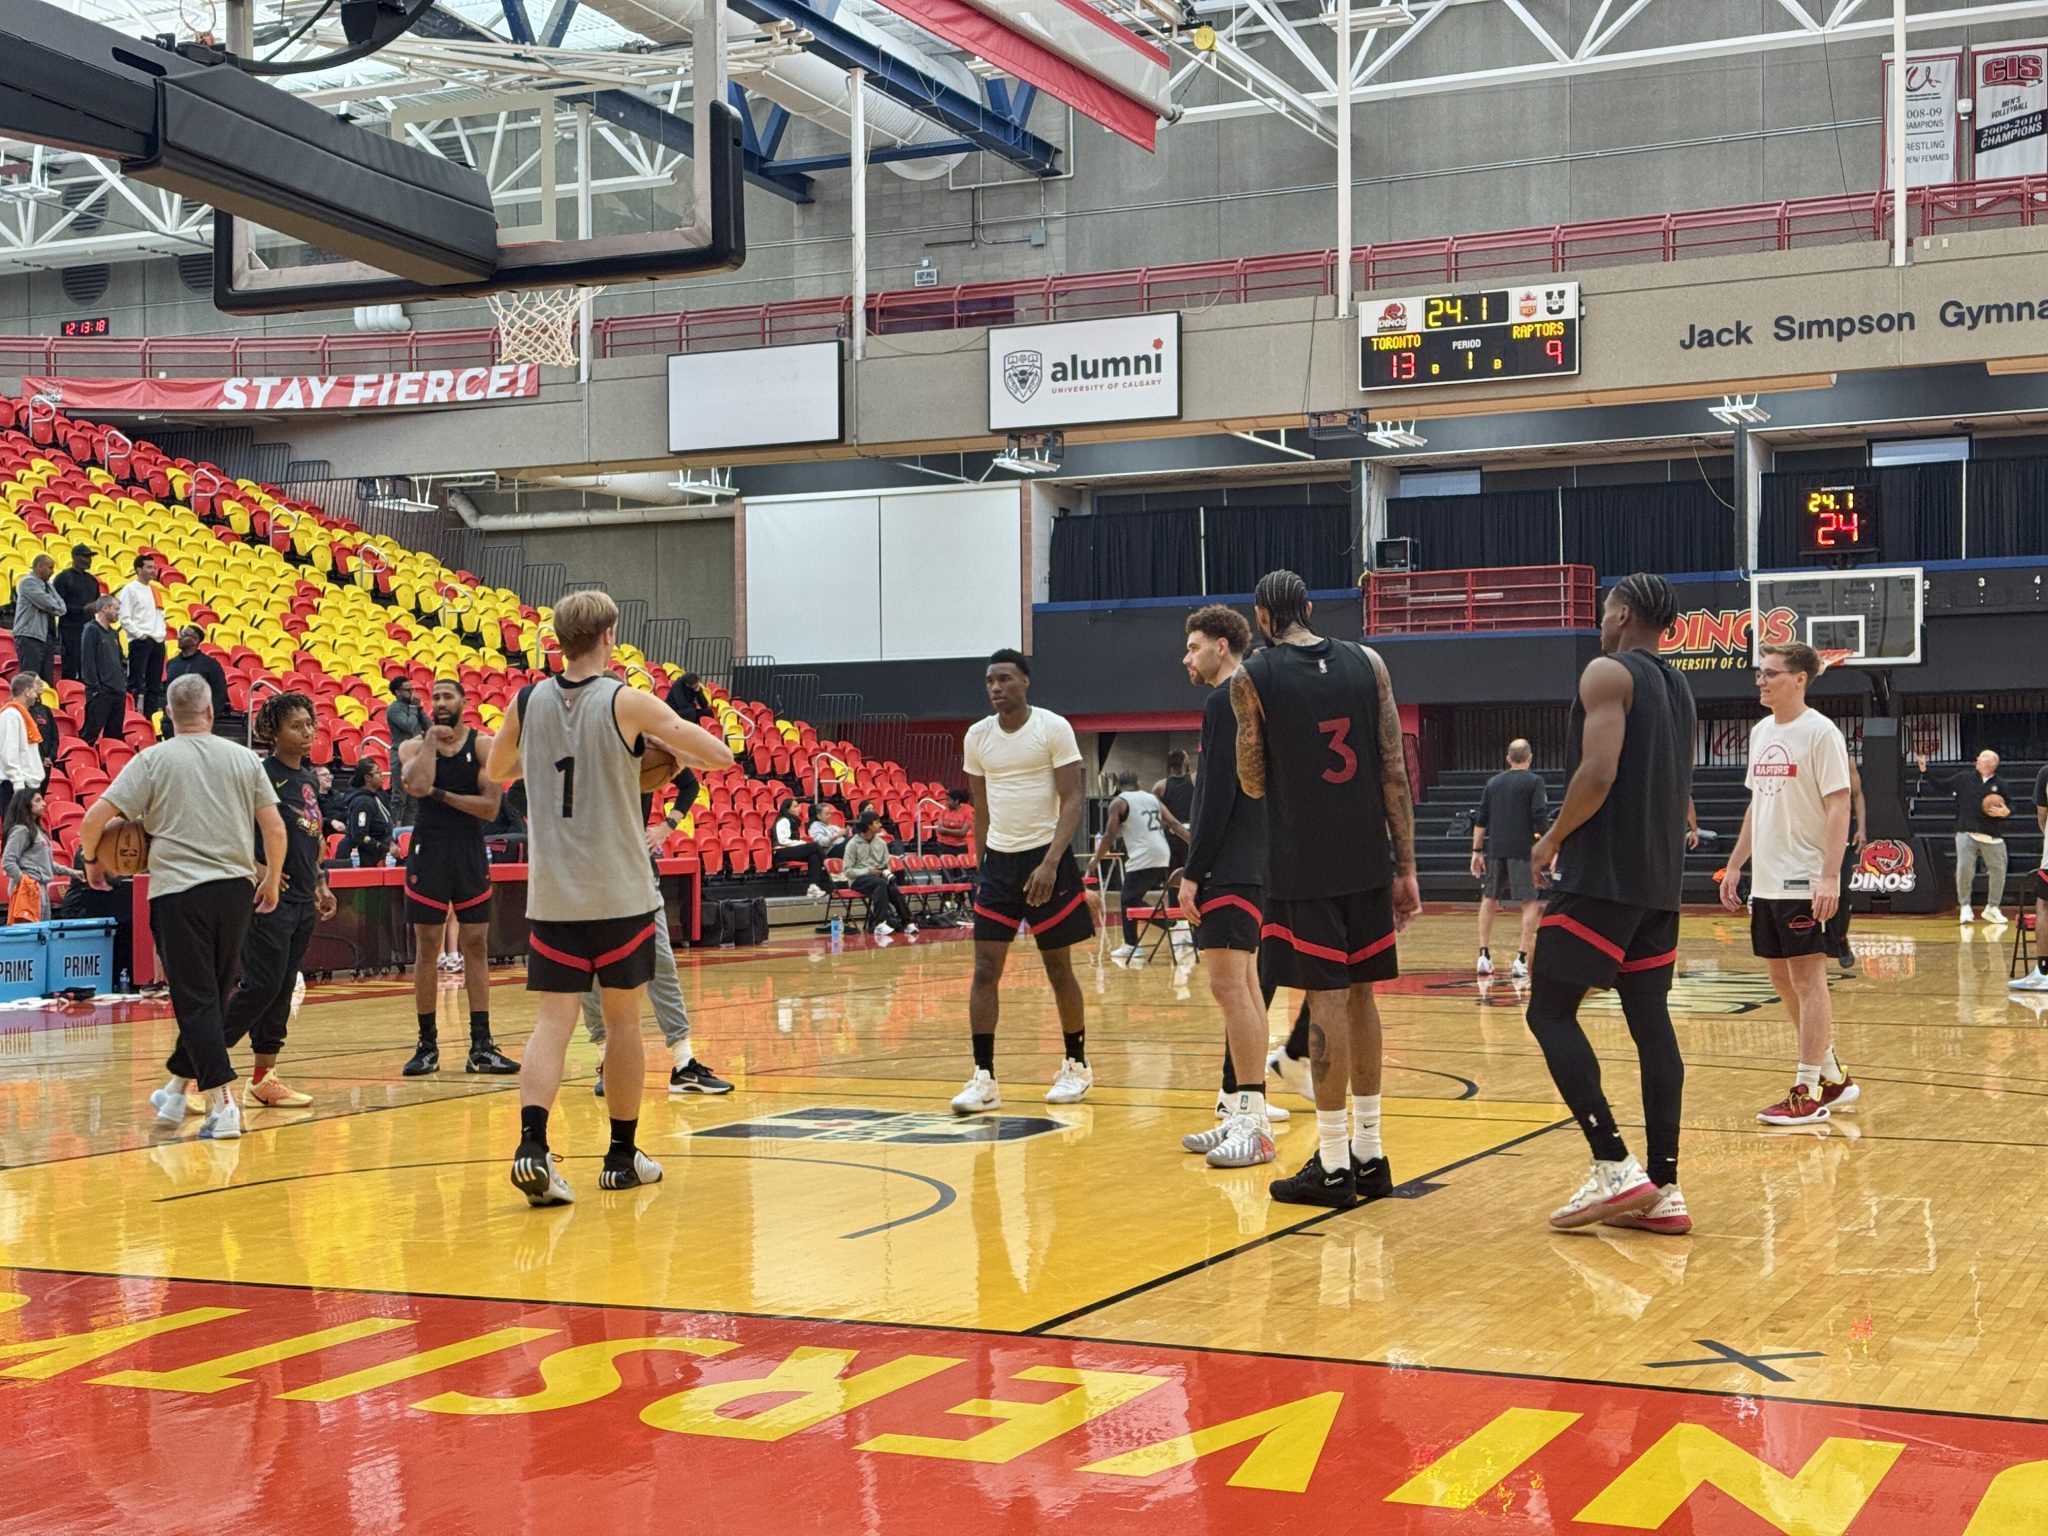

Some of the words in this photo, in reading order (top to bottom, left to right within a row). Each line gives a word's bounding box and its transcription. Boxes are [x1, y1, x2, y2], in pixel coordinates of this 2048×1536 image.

[1983, 55, 2042, 85] CIS
[1991, 101, 2029, 119] VOLLEYBALL
[2002, 96, 2022, 107] MEN'S
[1906, 107, 1942, 119] 008-09
[1980, 121, 2043, 149] CHAMPIONS
[1982, 113, 2042, 138] 2009-2010
[1906, 140, 1945, 151] RESTLING
[1922, 153, 1950, 162] FEMMES
[1428, 297, 1488, 327] 24.1
[1378, 318, 1407, 328] DINOS
[1512, 321, 1565, 339] RAPTORS
[1680, 320, 1753, 350] Jack
[1773, 311, 1916, 342] Simpson
[1371, 334, 1421, 351] TORONTO
[1452, 339, 1481, 350] PERIOD
[1546, 340, 1562, 365] 9
[1051, 338, 1163, 382] alumni
[1392, 352, 1415, 379] 13
[1467, 351, 1474, 370] 1
[217, 376, 338, 409] STAY
[349, 363, 529, 407] FIERCE!
[1051, 383, 1105, 395] UNIVERSITY
[1107, 381, 1119, 390] OF
[1122, 378, 1162, 389] CALGARY
[1808, 492, 1854, 513] 24.1
[1817, 512, 1859, 545] 24
[1923, 580, 1930, 589] 2
[1978, 577, 1985, 587] 3
[2034, 575, 2041, 585] 4
[1658, 606, 1799, 656] DINOS
[1720, 656, 1735, 669] OF
[1318, 717, 1358, 784] 3
[1755, 765, 1790, 776] RAPTORS
[554, 756, 575, 818] 1
[1848, 871, 1917, 893] DINOS
[64, 955, 101, 978] PRIME
